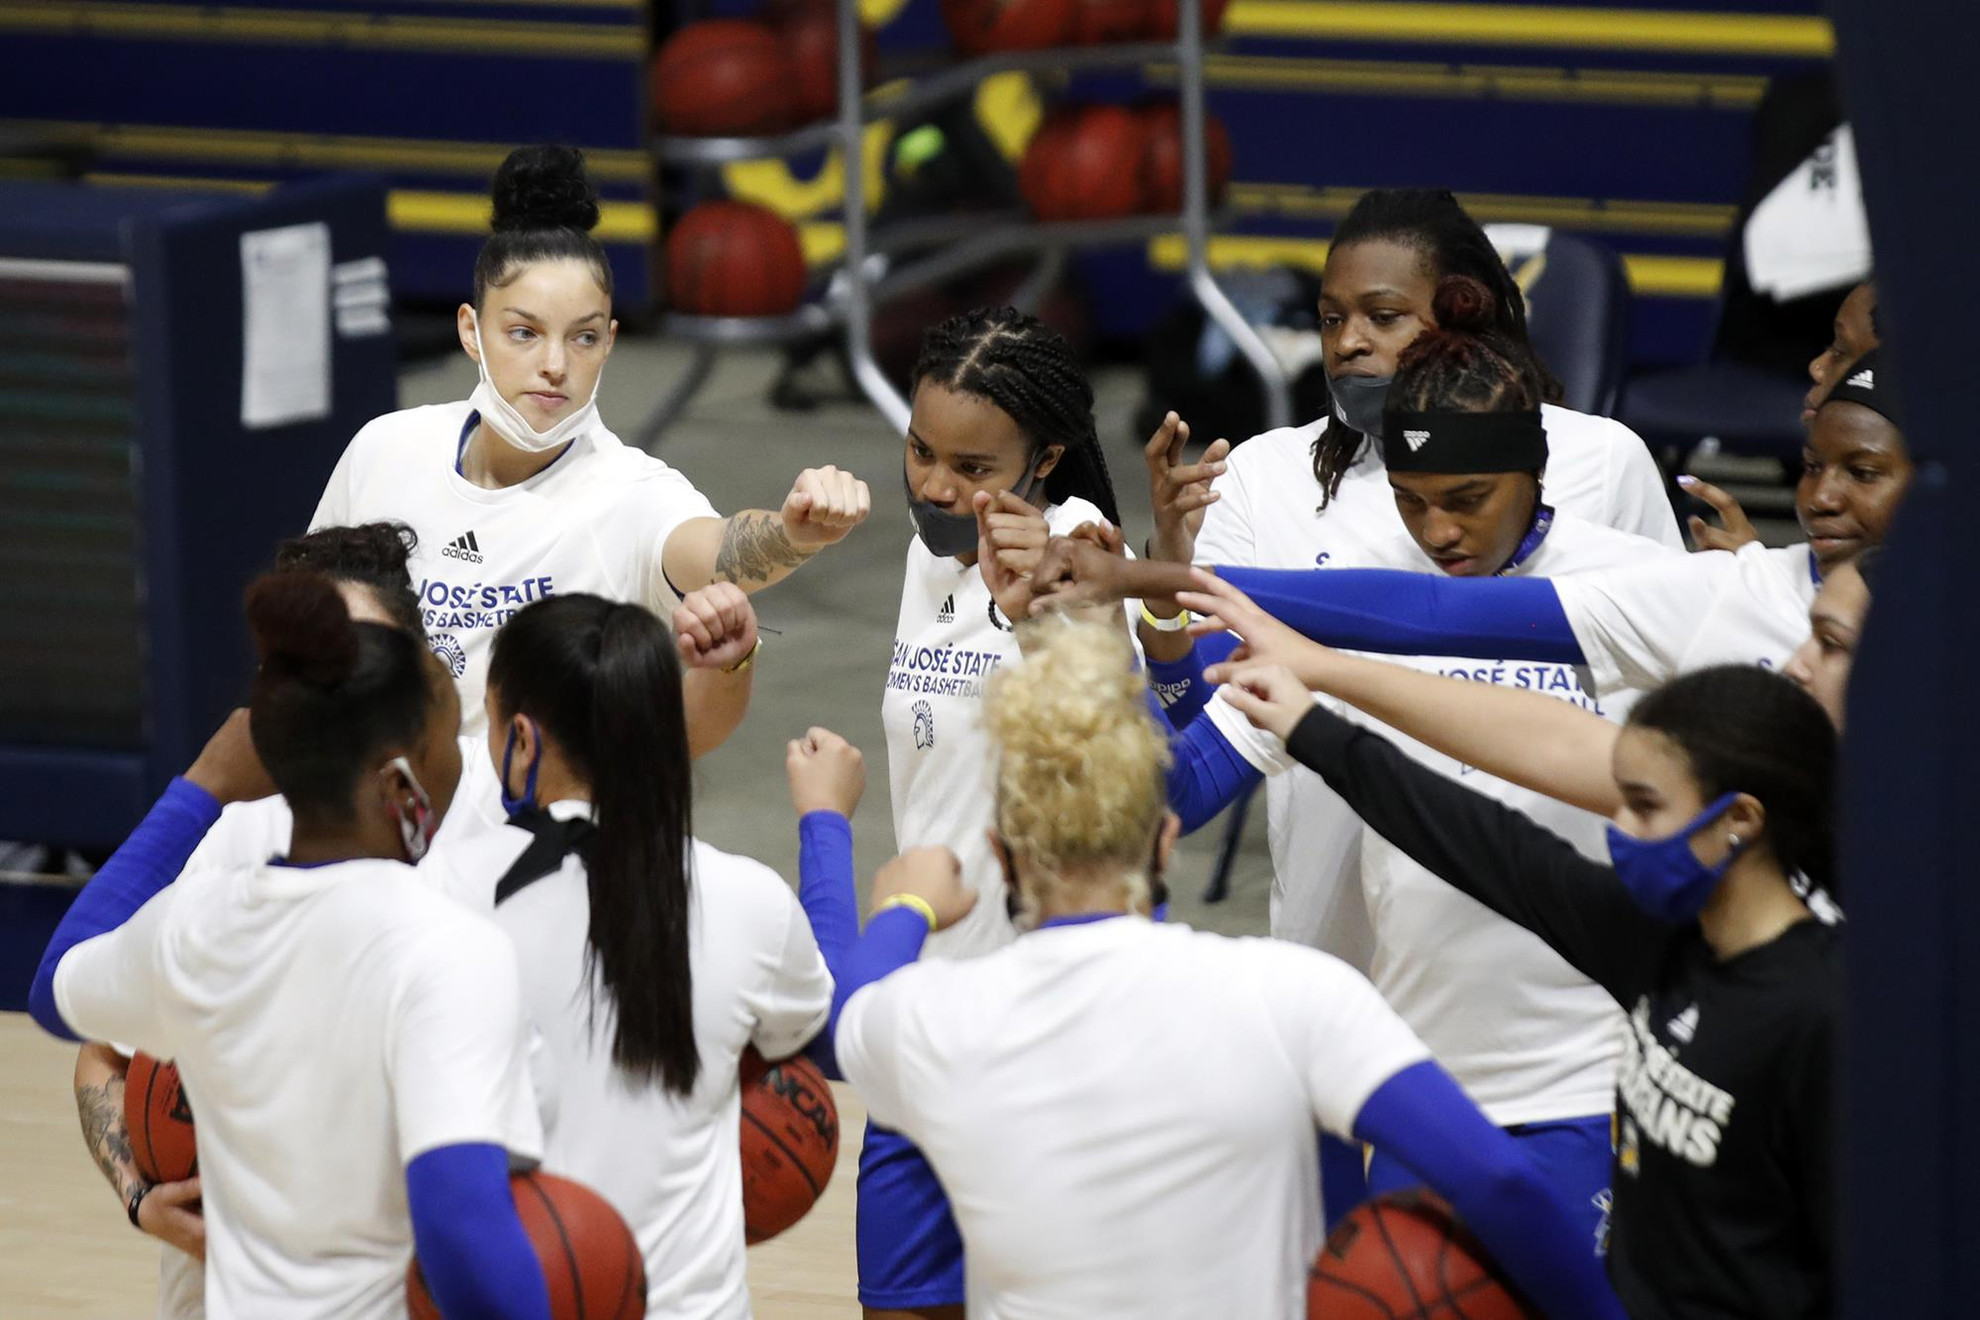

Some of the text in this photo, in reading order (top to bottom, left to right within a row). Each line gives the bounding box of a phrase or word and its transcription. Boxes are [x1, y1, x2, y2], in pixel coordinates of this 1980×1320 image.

[441, 546, 484, 564] adidas
[481, 576, 554, 608] STATE
[908, 642, 954, 672] JOSÉ
[1148, 678, 1191, 694] adida
[1514, 666, 1583, 692] STA
